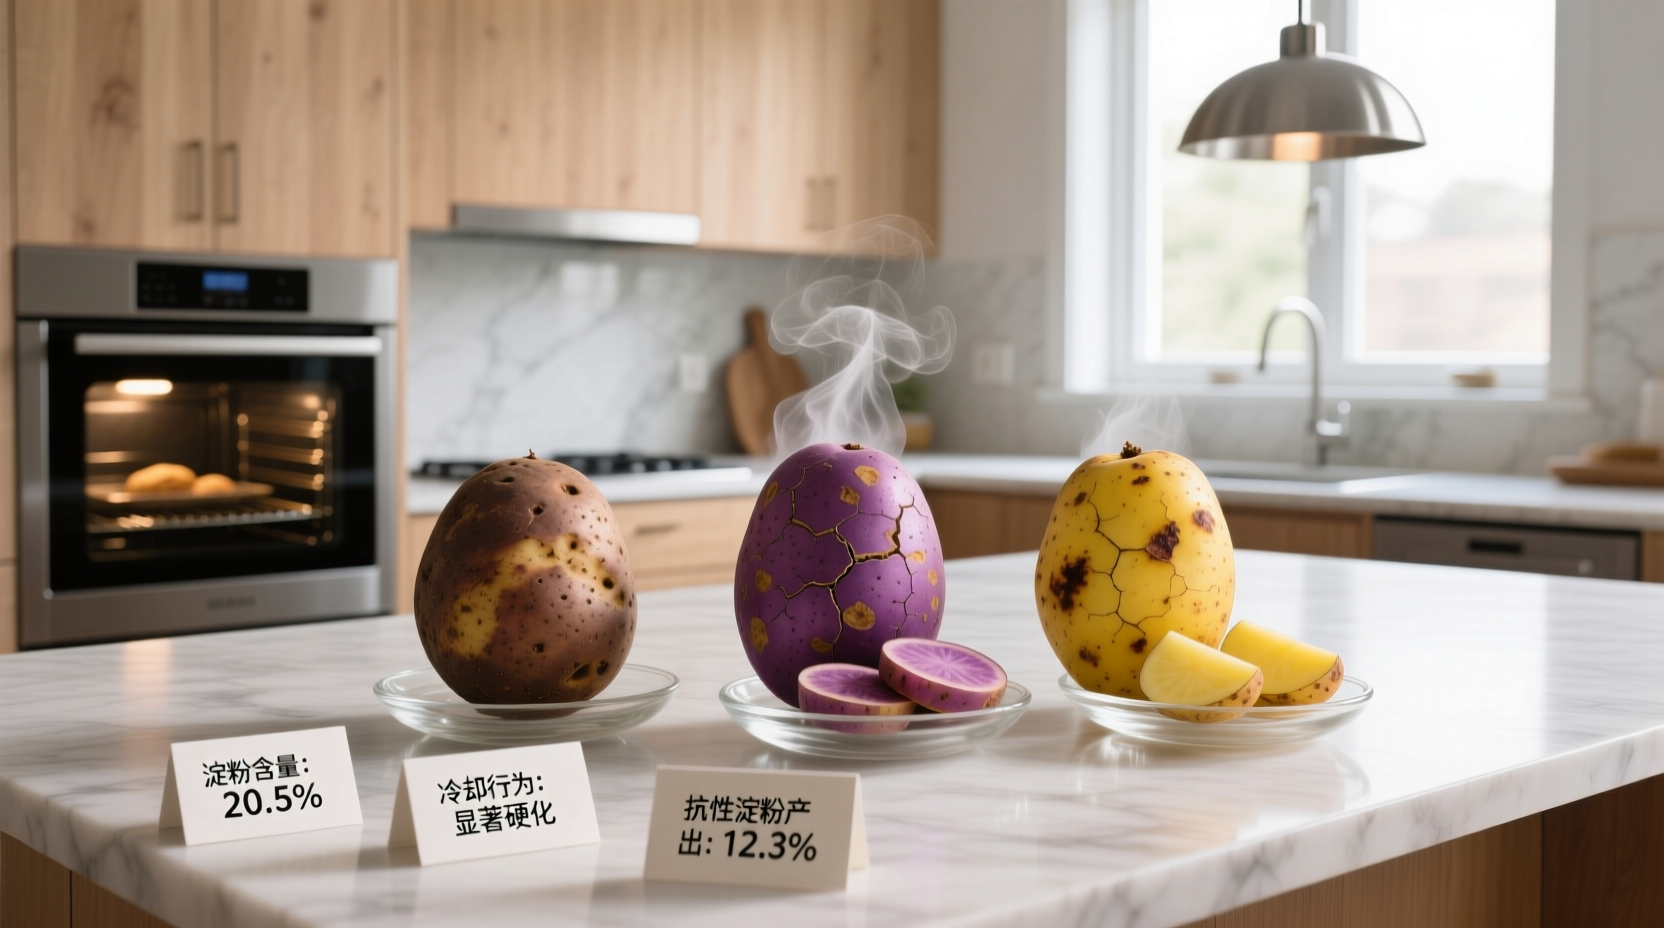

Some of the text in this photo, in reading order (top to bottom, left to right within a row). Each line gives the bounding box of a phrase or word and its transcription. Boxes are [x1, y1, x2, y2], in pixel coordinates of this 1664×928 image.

[223, 782, 323, 818] 20.5%
[683, 794, 812, 825] 抗性淀粉产
[455, 800, 557, 837] 显著硬化
[723, 829, 817, 862] 12.3%
